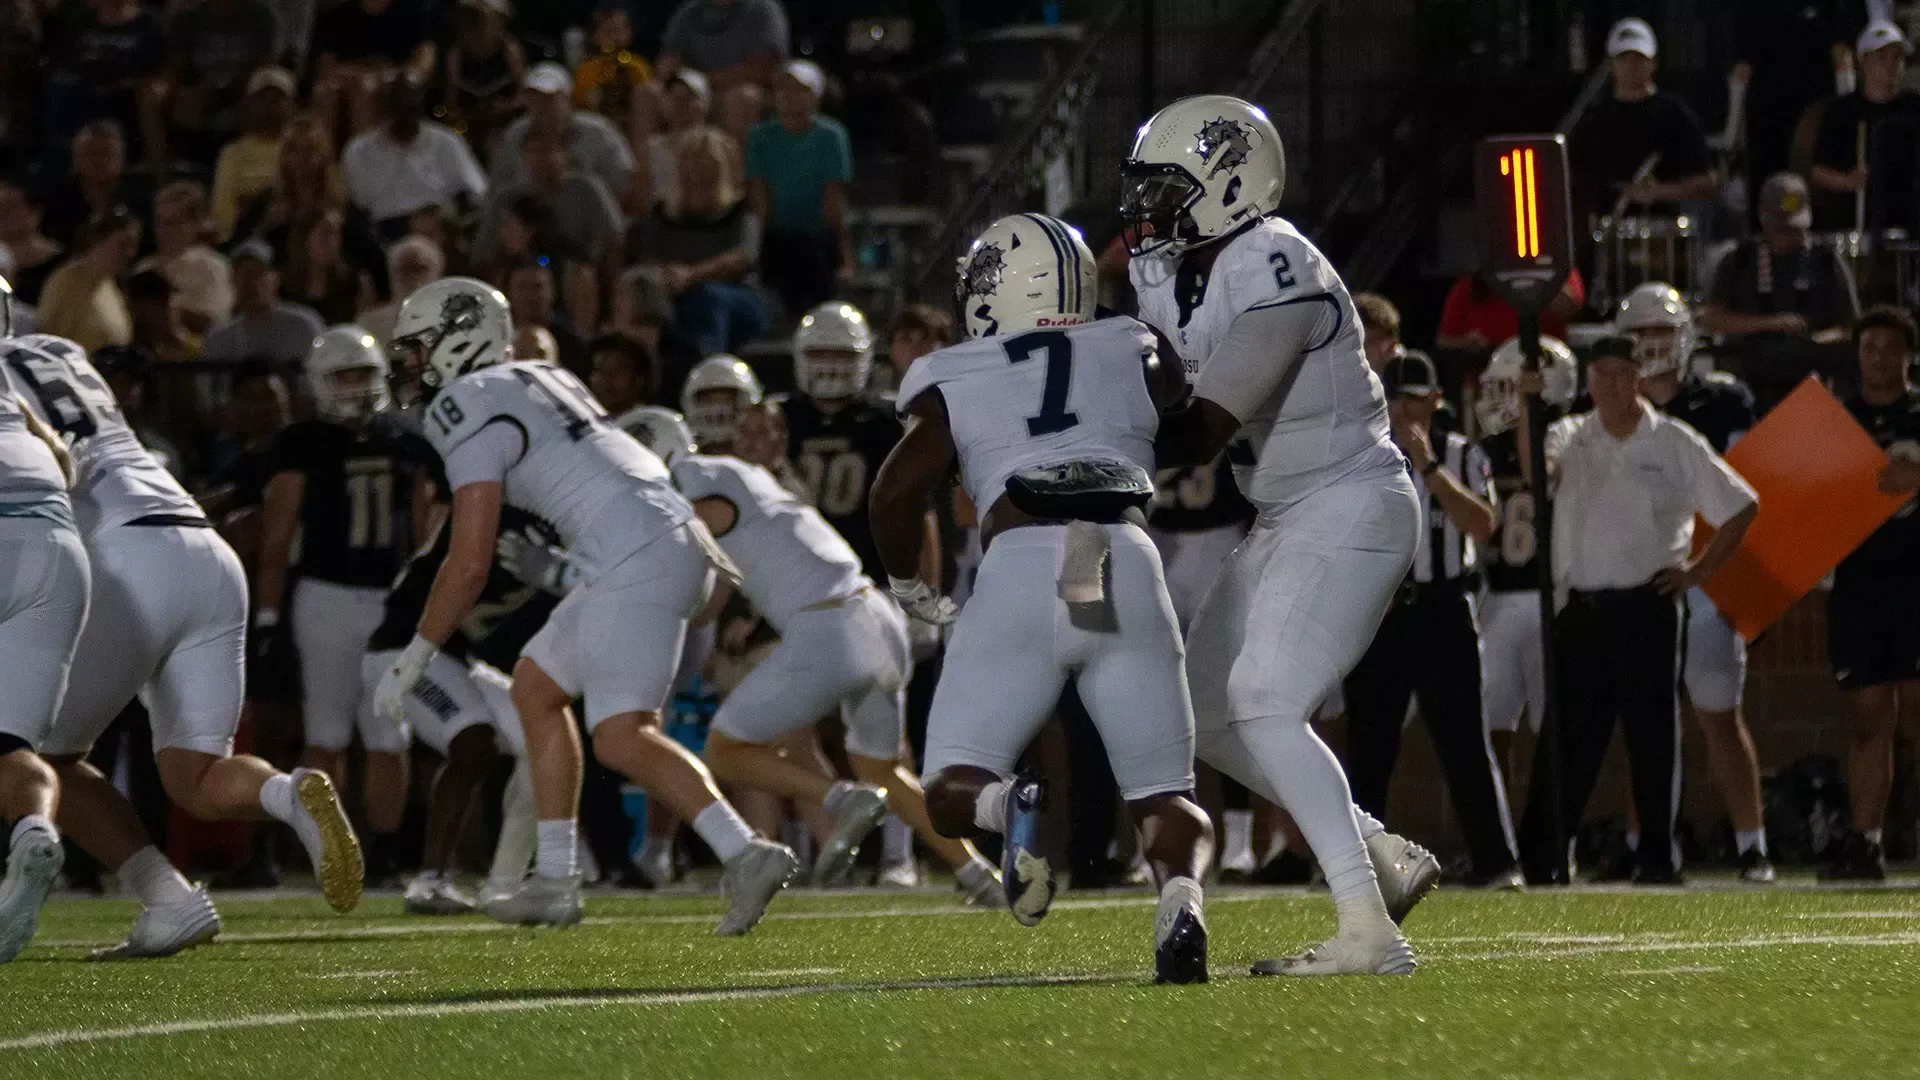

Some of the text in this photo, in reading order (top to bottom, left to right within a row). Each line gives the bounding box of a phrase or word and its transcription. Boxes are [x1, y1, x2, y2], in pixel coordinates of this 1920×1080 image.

[1269, 251, 1296, 289] 2
[1002, 331, 1080, 438] 7
[431, 395, 464, 435] 18
[344, 474, 394, 549] 11
